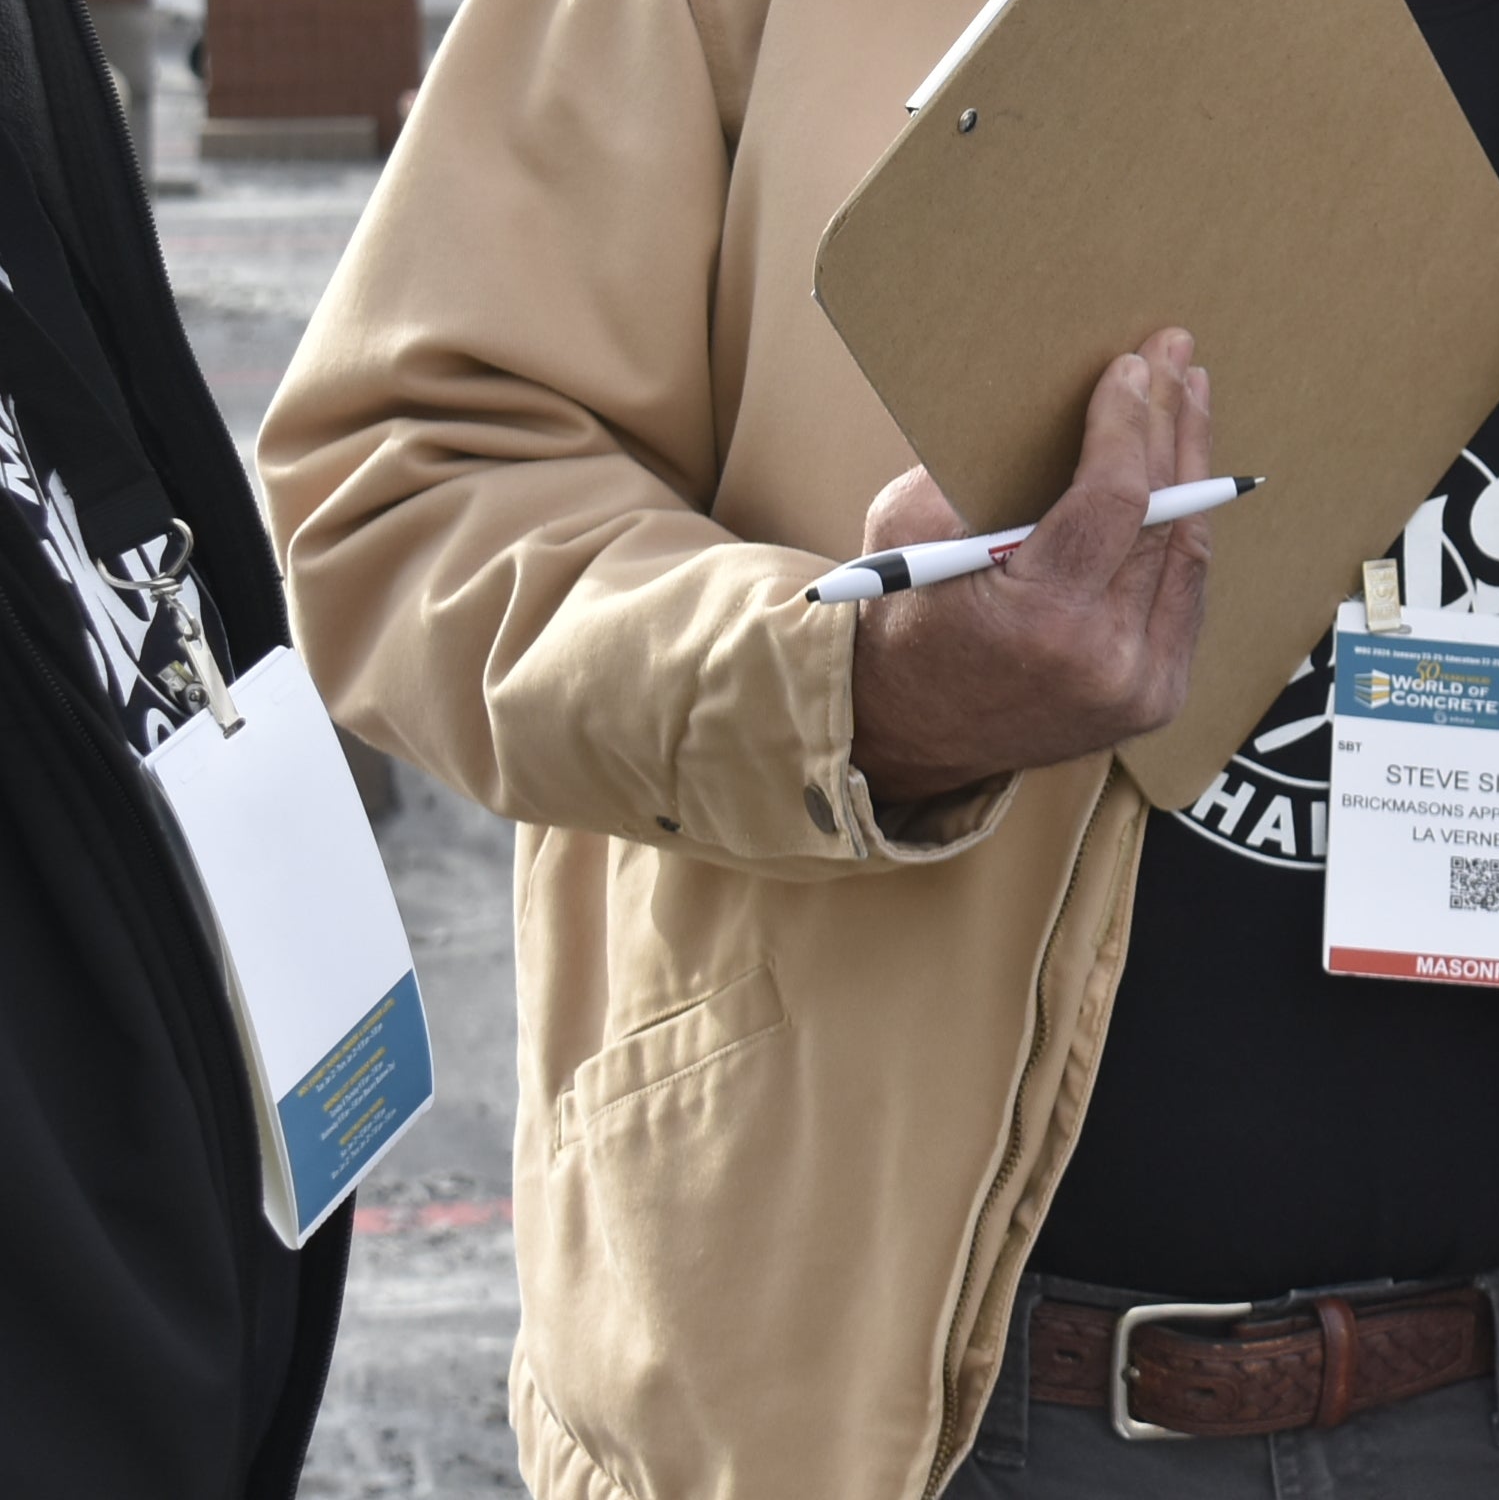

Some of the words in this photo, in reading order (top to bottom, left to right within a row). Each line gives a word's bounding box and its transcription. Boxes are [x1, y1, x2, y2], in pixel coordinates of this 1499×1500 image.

[1416, 660, 1441, 682] 50
[1391, 674, 1463, 696] WORLD
[1468, 686, 1490, 698] OF
[1391, 690, 1498, 715] CONCRETE
[1338, 740, 1362, 753] SBT
[1386, 764, 1470, 792] STEVE
[1341, 794, 1464, 819] BRICKMASONS
[1412, 825, 1435, 843] LA
